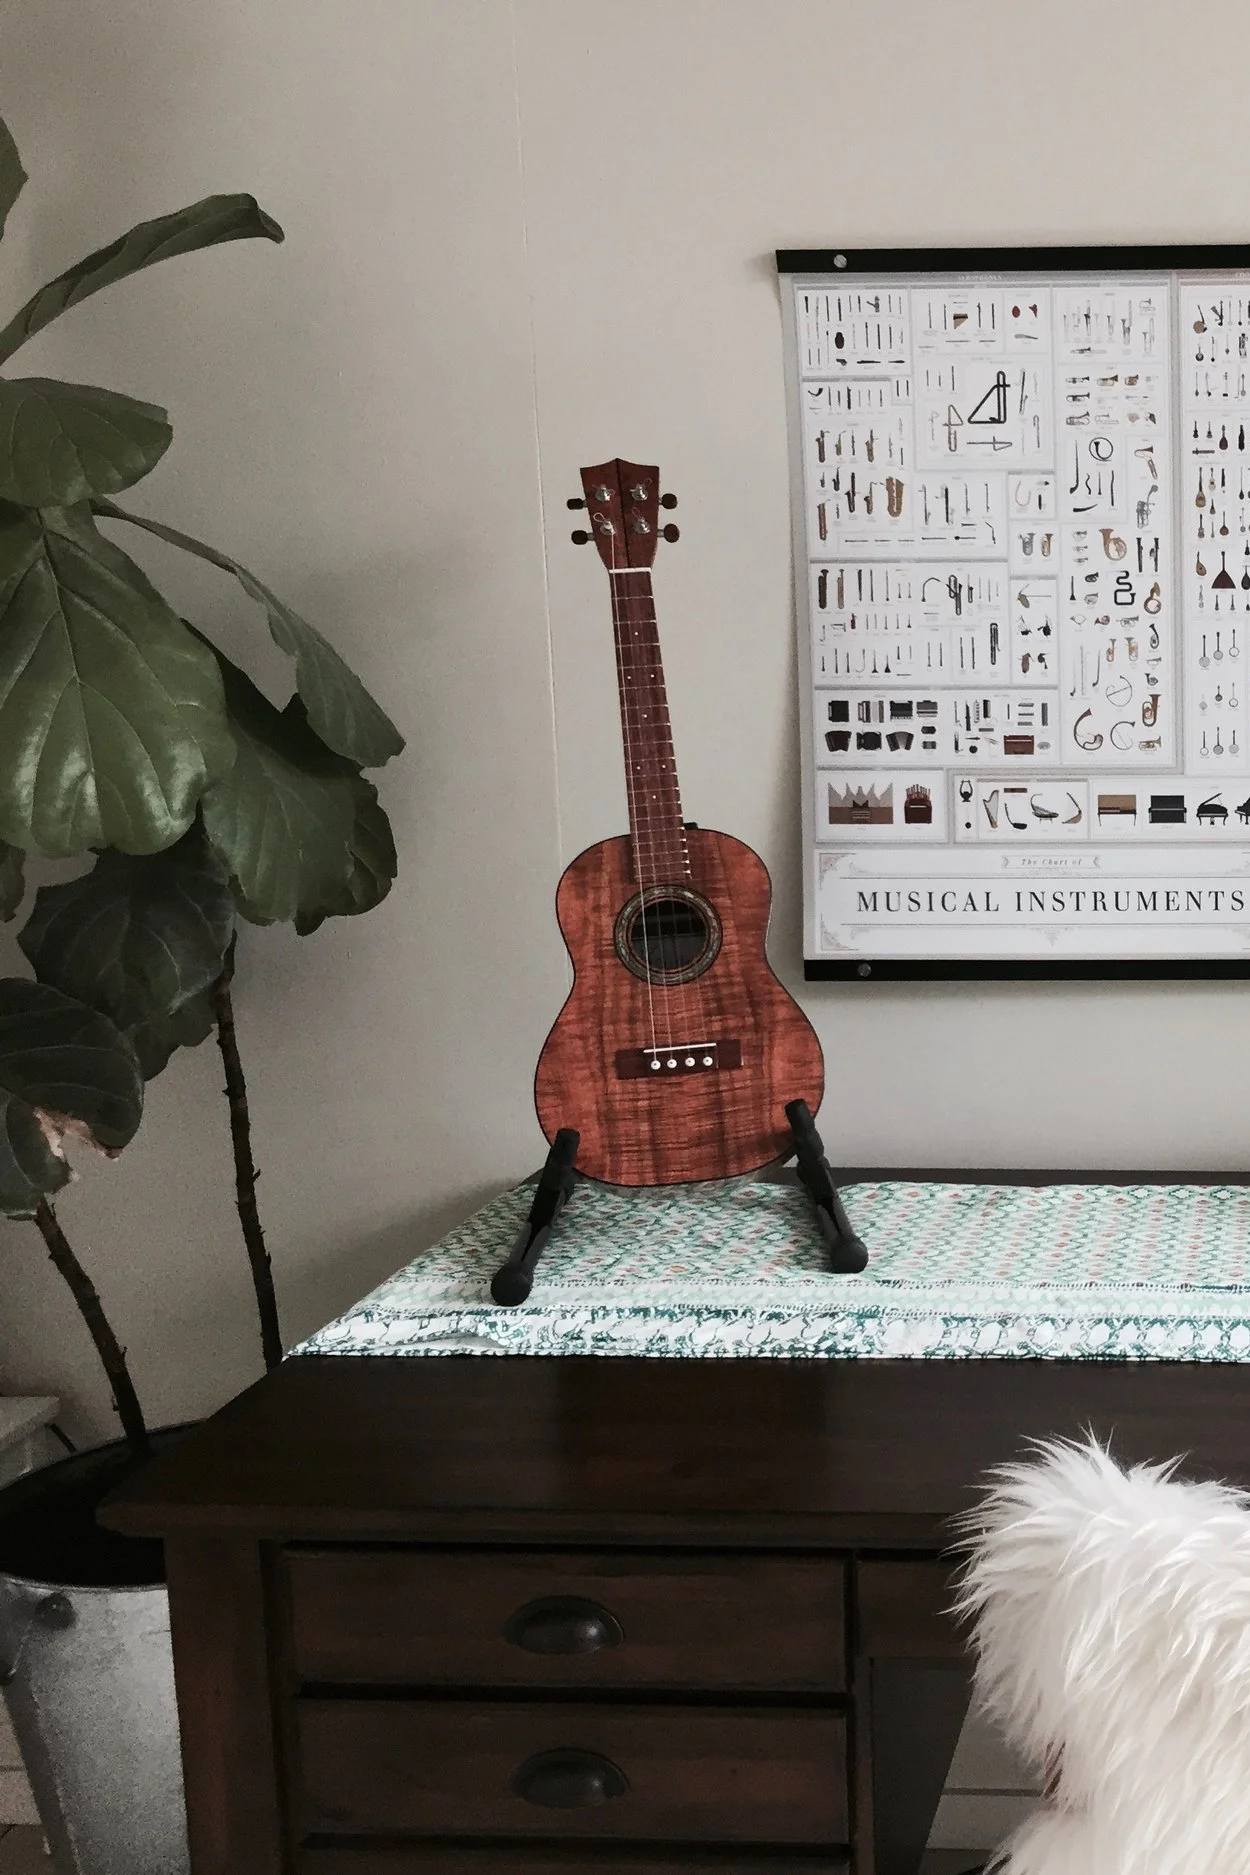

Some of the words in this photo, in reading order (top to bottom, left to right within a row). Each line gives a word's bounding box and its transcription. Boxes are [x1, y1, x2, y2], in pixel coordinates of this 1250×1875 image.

[1021, 858, 1037, 866] The
[1041, 858, 1068, 866] Chart
[857, 890, 1000, 912] MUSICAL
[1015, 890, 1245, 912] INSTRUMENTS
